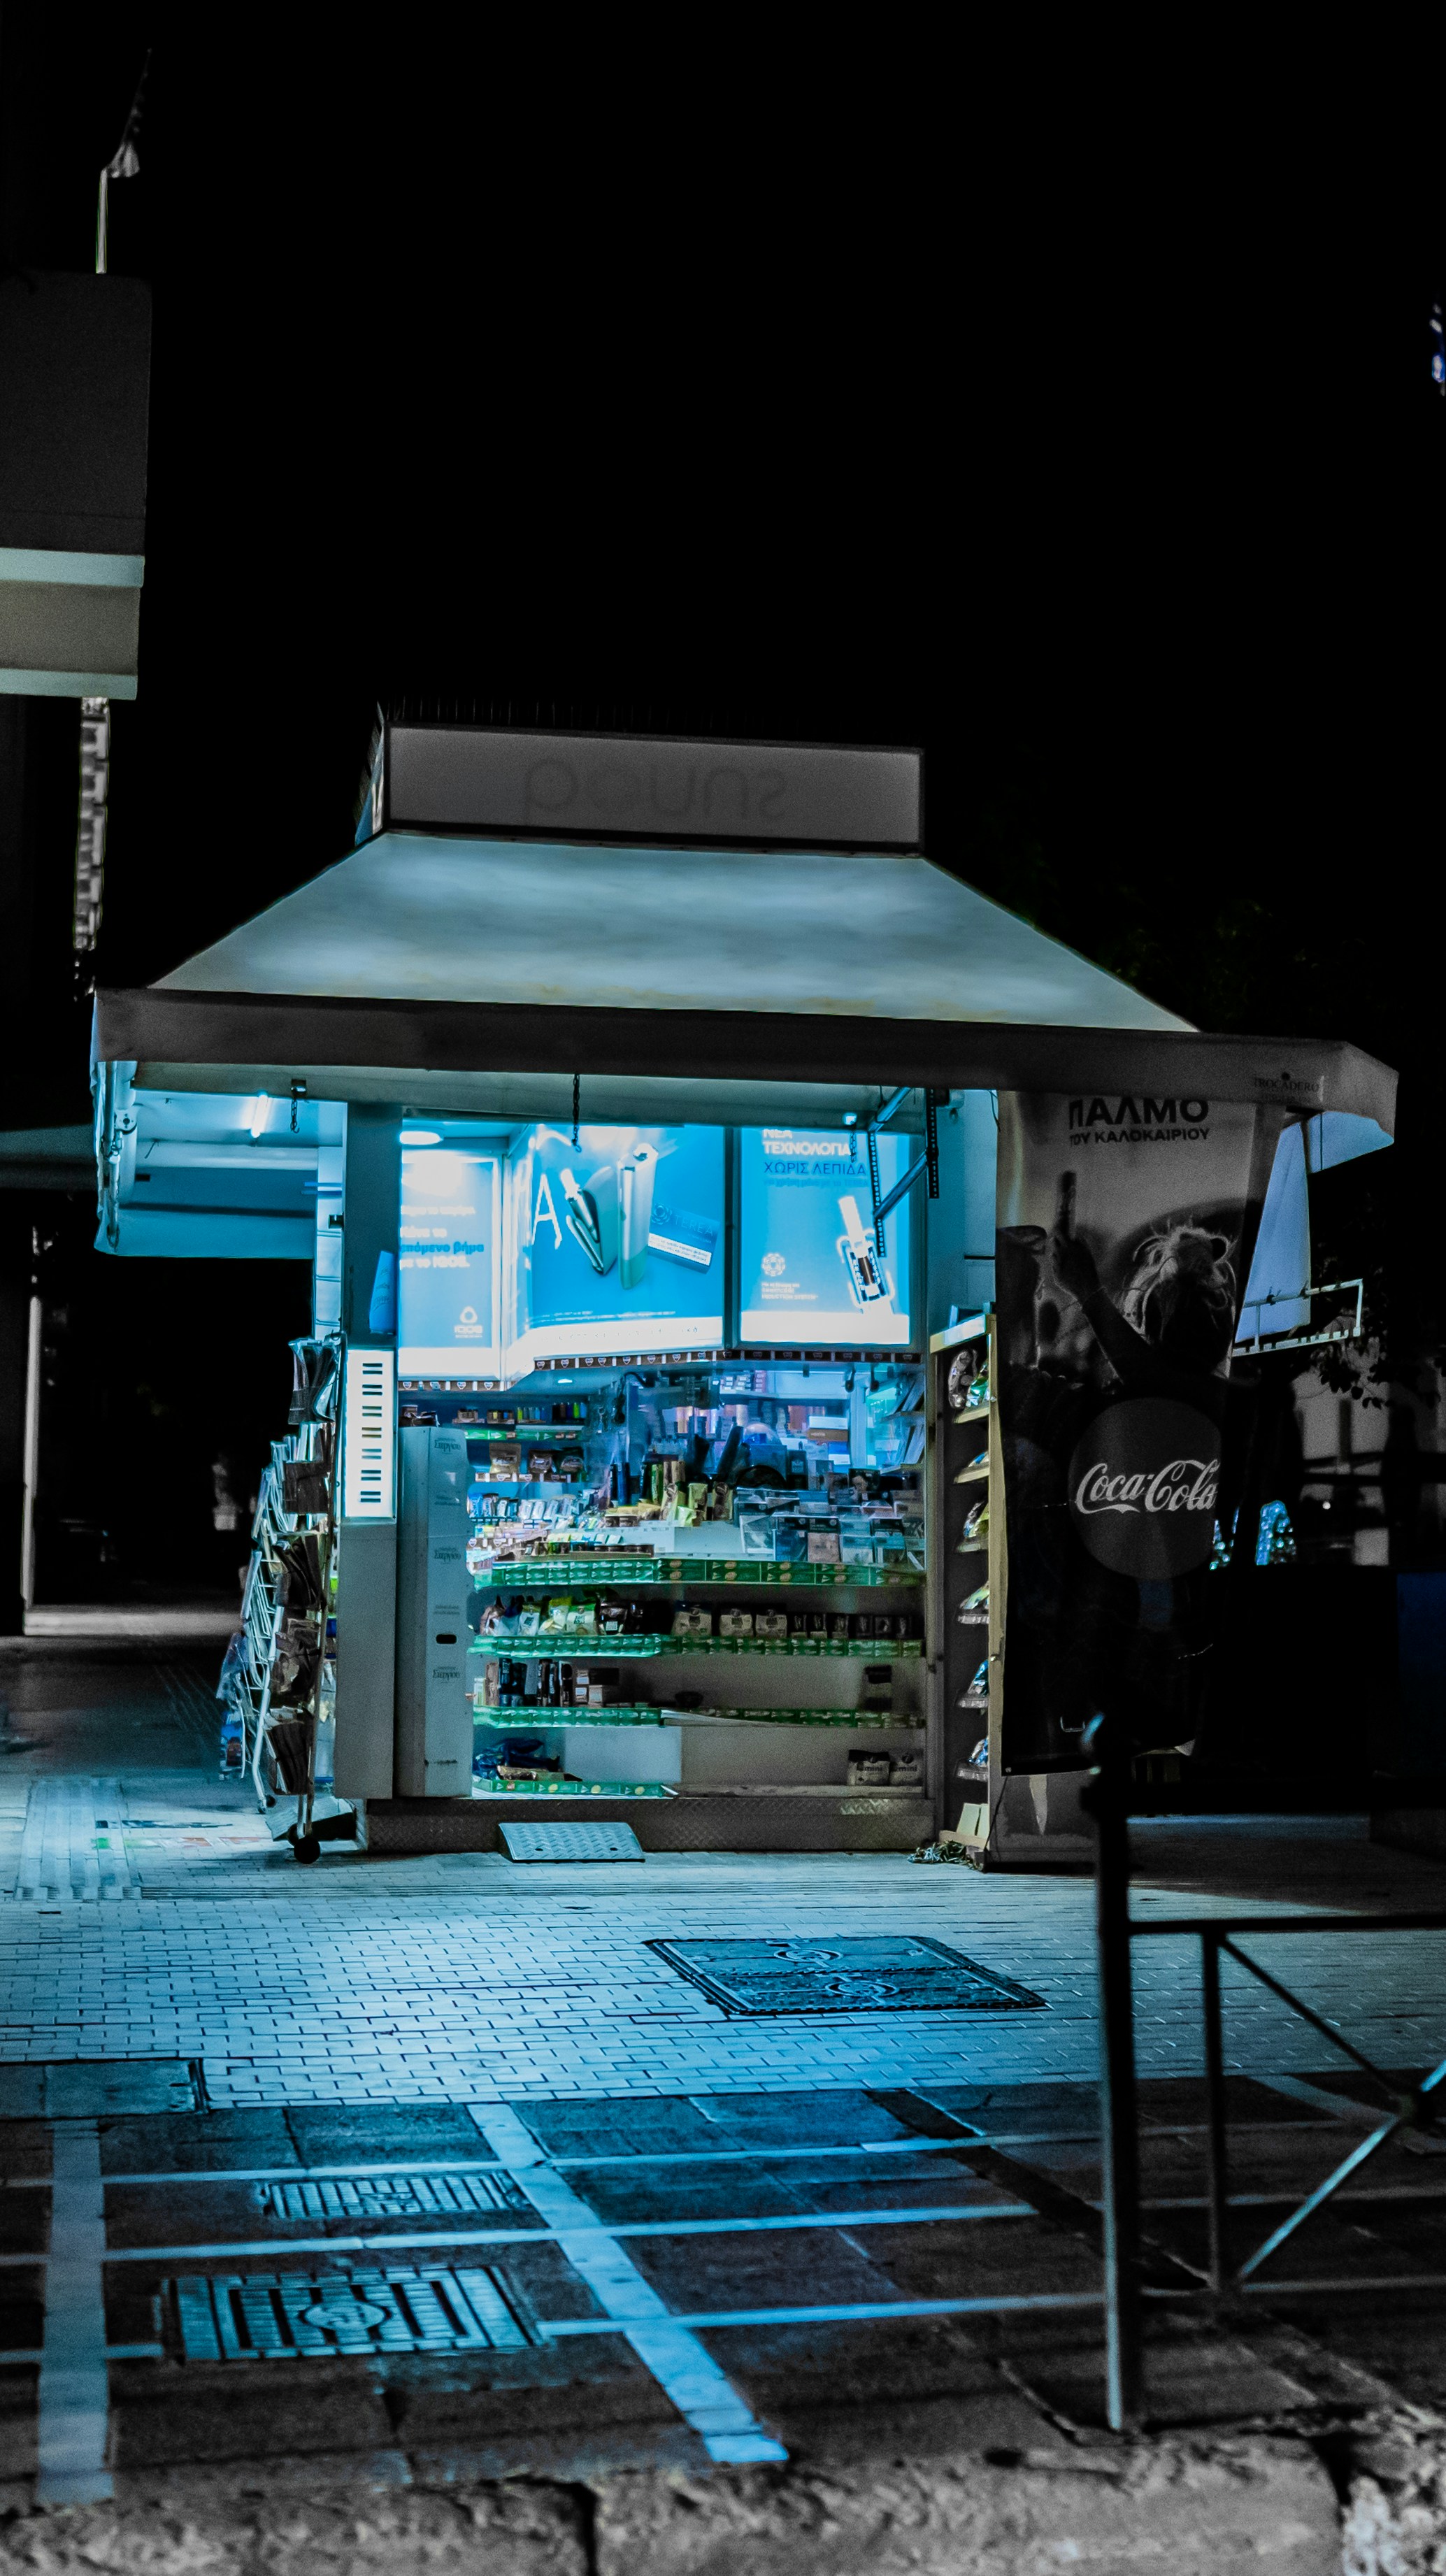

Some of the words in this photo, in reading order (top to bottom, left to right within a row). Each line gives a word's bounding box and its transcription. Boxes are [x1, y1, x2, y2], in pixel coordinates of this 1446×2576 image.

[1254, 1077, 1319, 1093] TROCADERO
[1095, 1128, 1210, 1143] ΚΑΛΟΚΑΙΡΙΟΥ
[763, 1142, 852, 1157] ΤΕΧΝΟΛΟΓΙΑ
[764, 1161, 810, 1174] ΧΩΡΙΣ
[813, 1162, 866, 1176] ΛΕΠΙΔΑ
[675, 1215, 713, 1236] TEREA
[453, 1241, 485, 1255] βήμα
[1075, 1459, 1221, 1515] Coca-Cola
